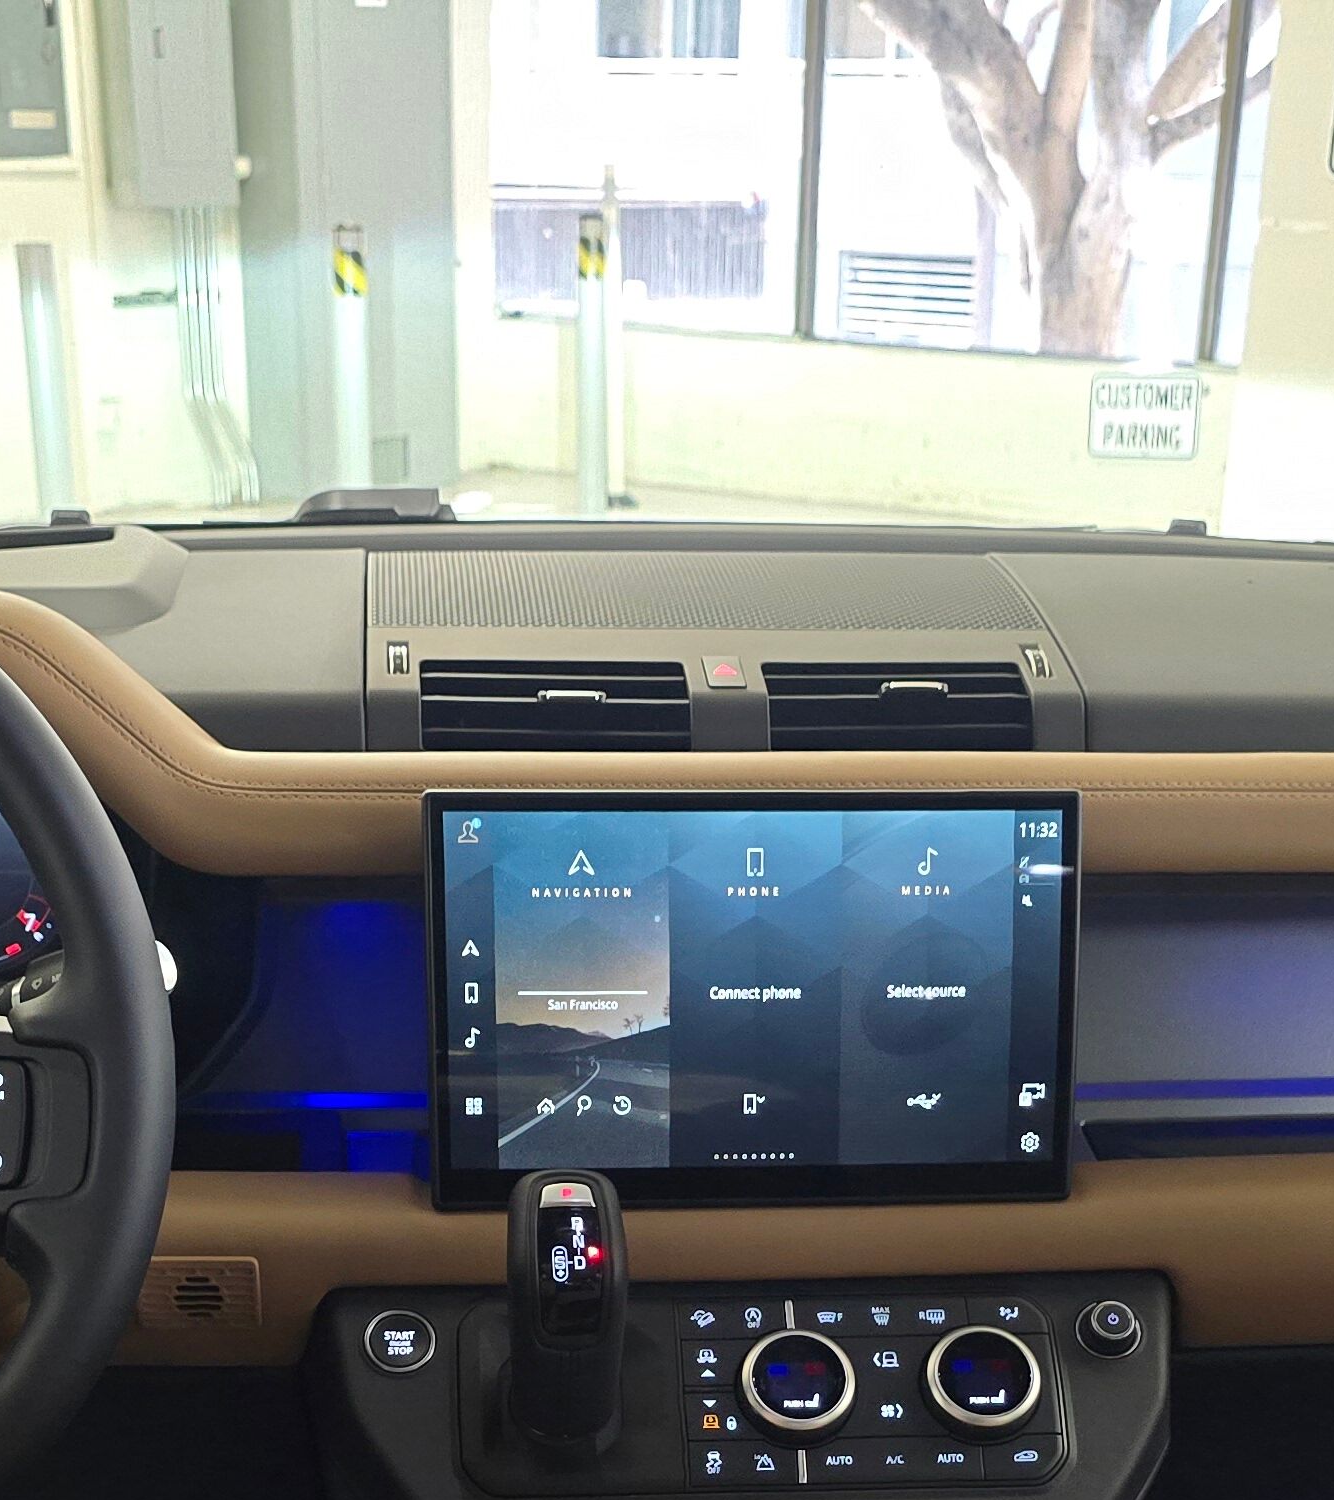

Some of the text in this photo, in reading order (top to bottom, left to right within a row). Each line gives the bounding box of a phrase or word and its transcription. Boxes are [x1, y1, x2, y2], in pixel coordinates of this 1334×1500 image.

[1096, 383, 1193, 410] CUSTOMER
[1103, 422, 1181, 450] PARKING
[1019, 821, 1058, 838] 11:32
[531, 887, 633, 899] NAVIGATION
[727, 886, 780, 897] PHONE
[901, 885, 951, 896] MEDIA
[23, 912, 36, 932] 7
[709, 985, 802, 1003] Connect phone
[886, 984, 924, 999] Select
[547, 999, 619, 1011] San Francisco
[572, 1234, 585, 1249] N
[573, 1255, 587, 1270] D
[383, 1330, 416, 1341] START
[387, 1346, 414, 1356] STOP
[825, 1455, 854, 1467] AUTO
[885, 1455, 905, 1466] A/C
[937, 1453, 965, 1464] AUTO
